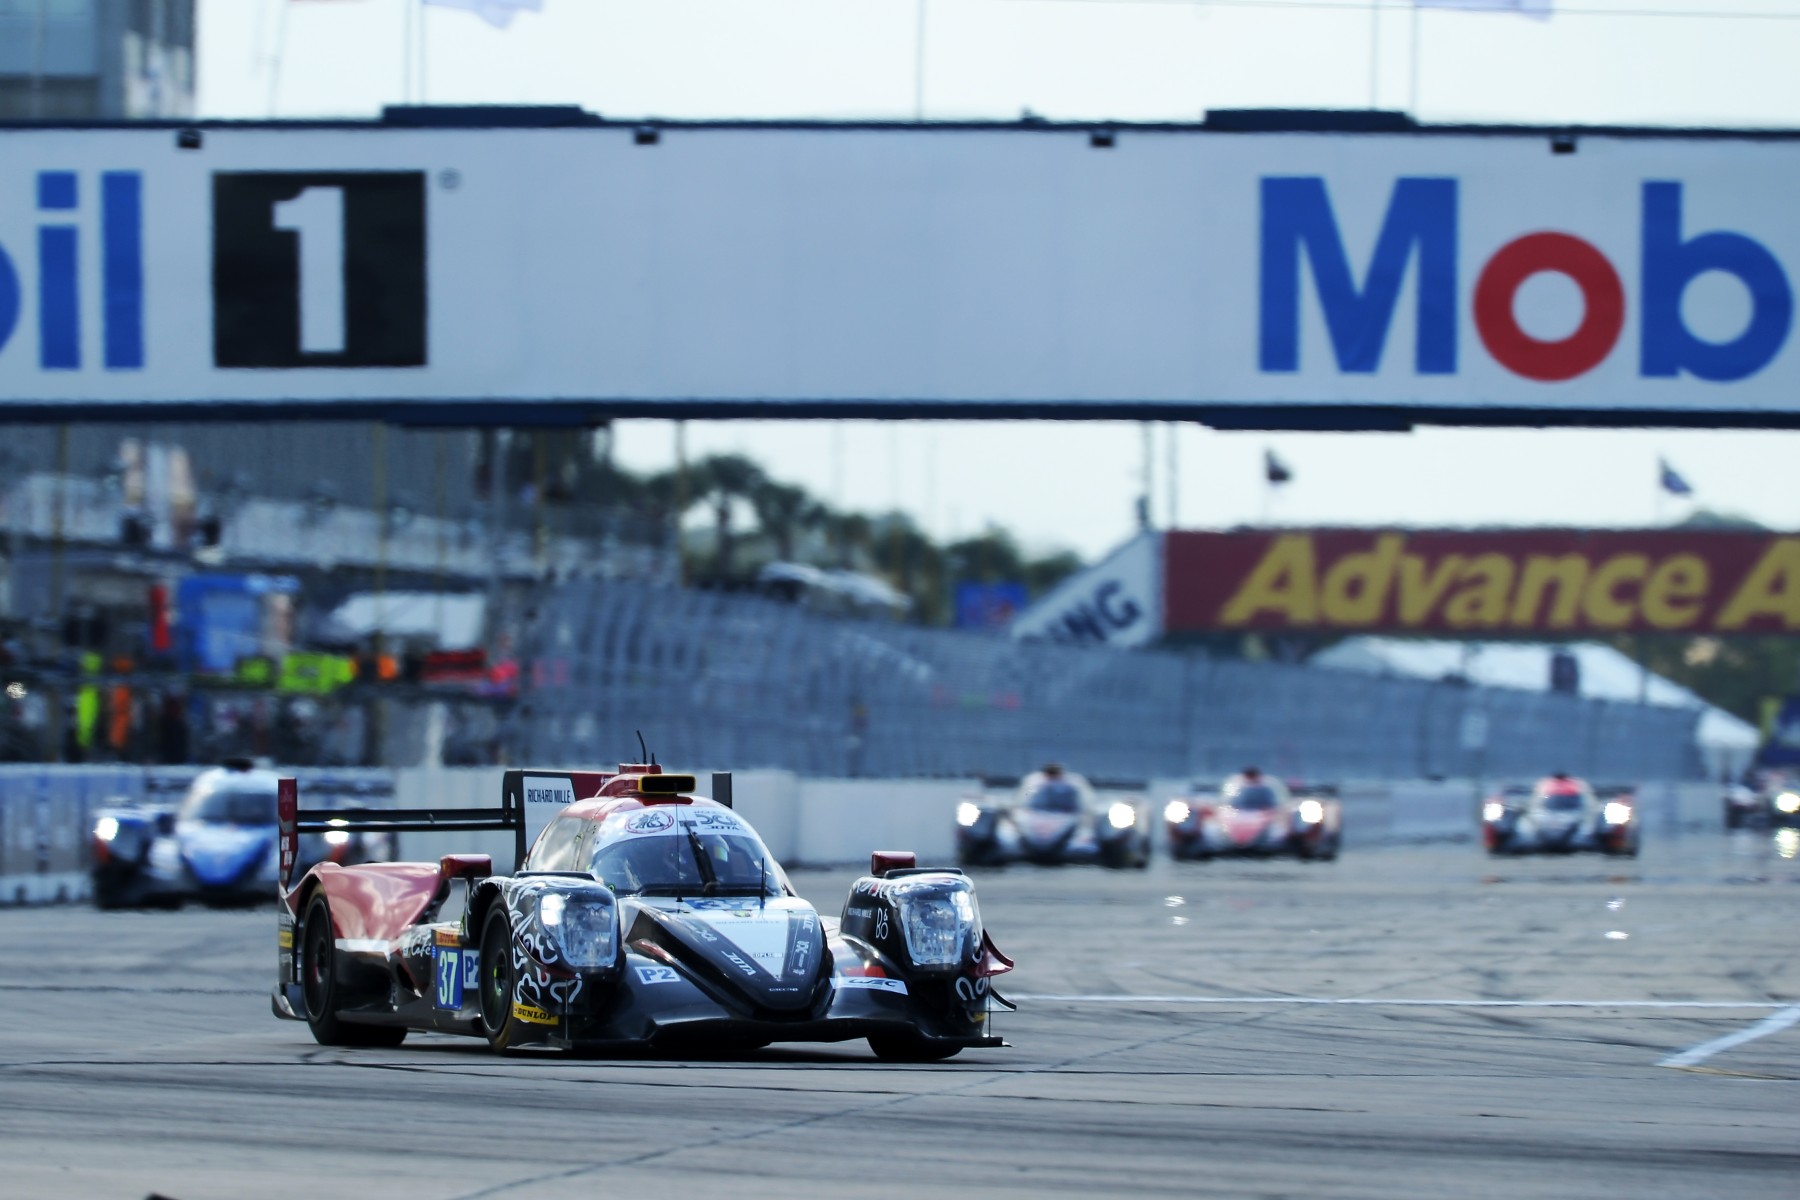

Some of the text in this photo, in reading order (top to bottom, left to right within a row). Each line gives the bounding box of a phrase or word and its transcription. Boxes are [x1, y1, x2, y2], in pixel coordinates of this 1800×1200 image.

[0, 171, 346, 370] il 1
[1259, 176, 1794, 382] Mob
[1219, 533, 1708, 627] Advance
[527, 789, 570, 804] RICHARD MILLE
[439, 950, 458, 1005] 37
[640, 968, 676, 981] P2
[720, 950, 757, 976] JOTA
[517, 1007, 556, 1021] DUNLOP
